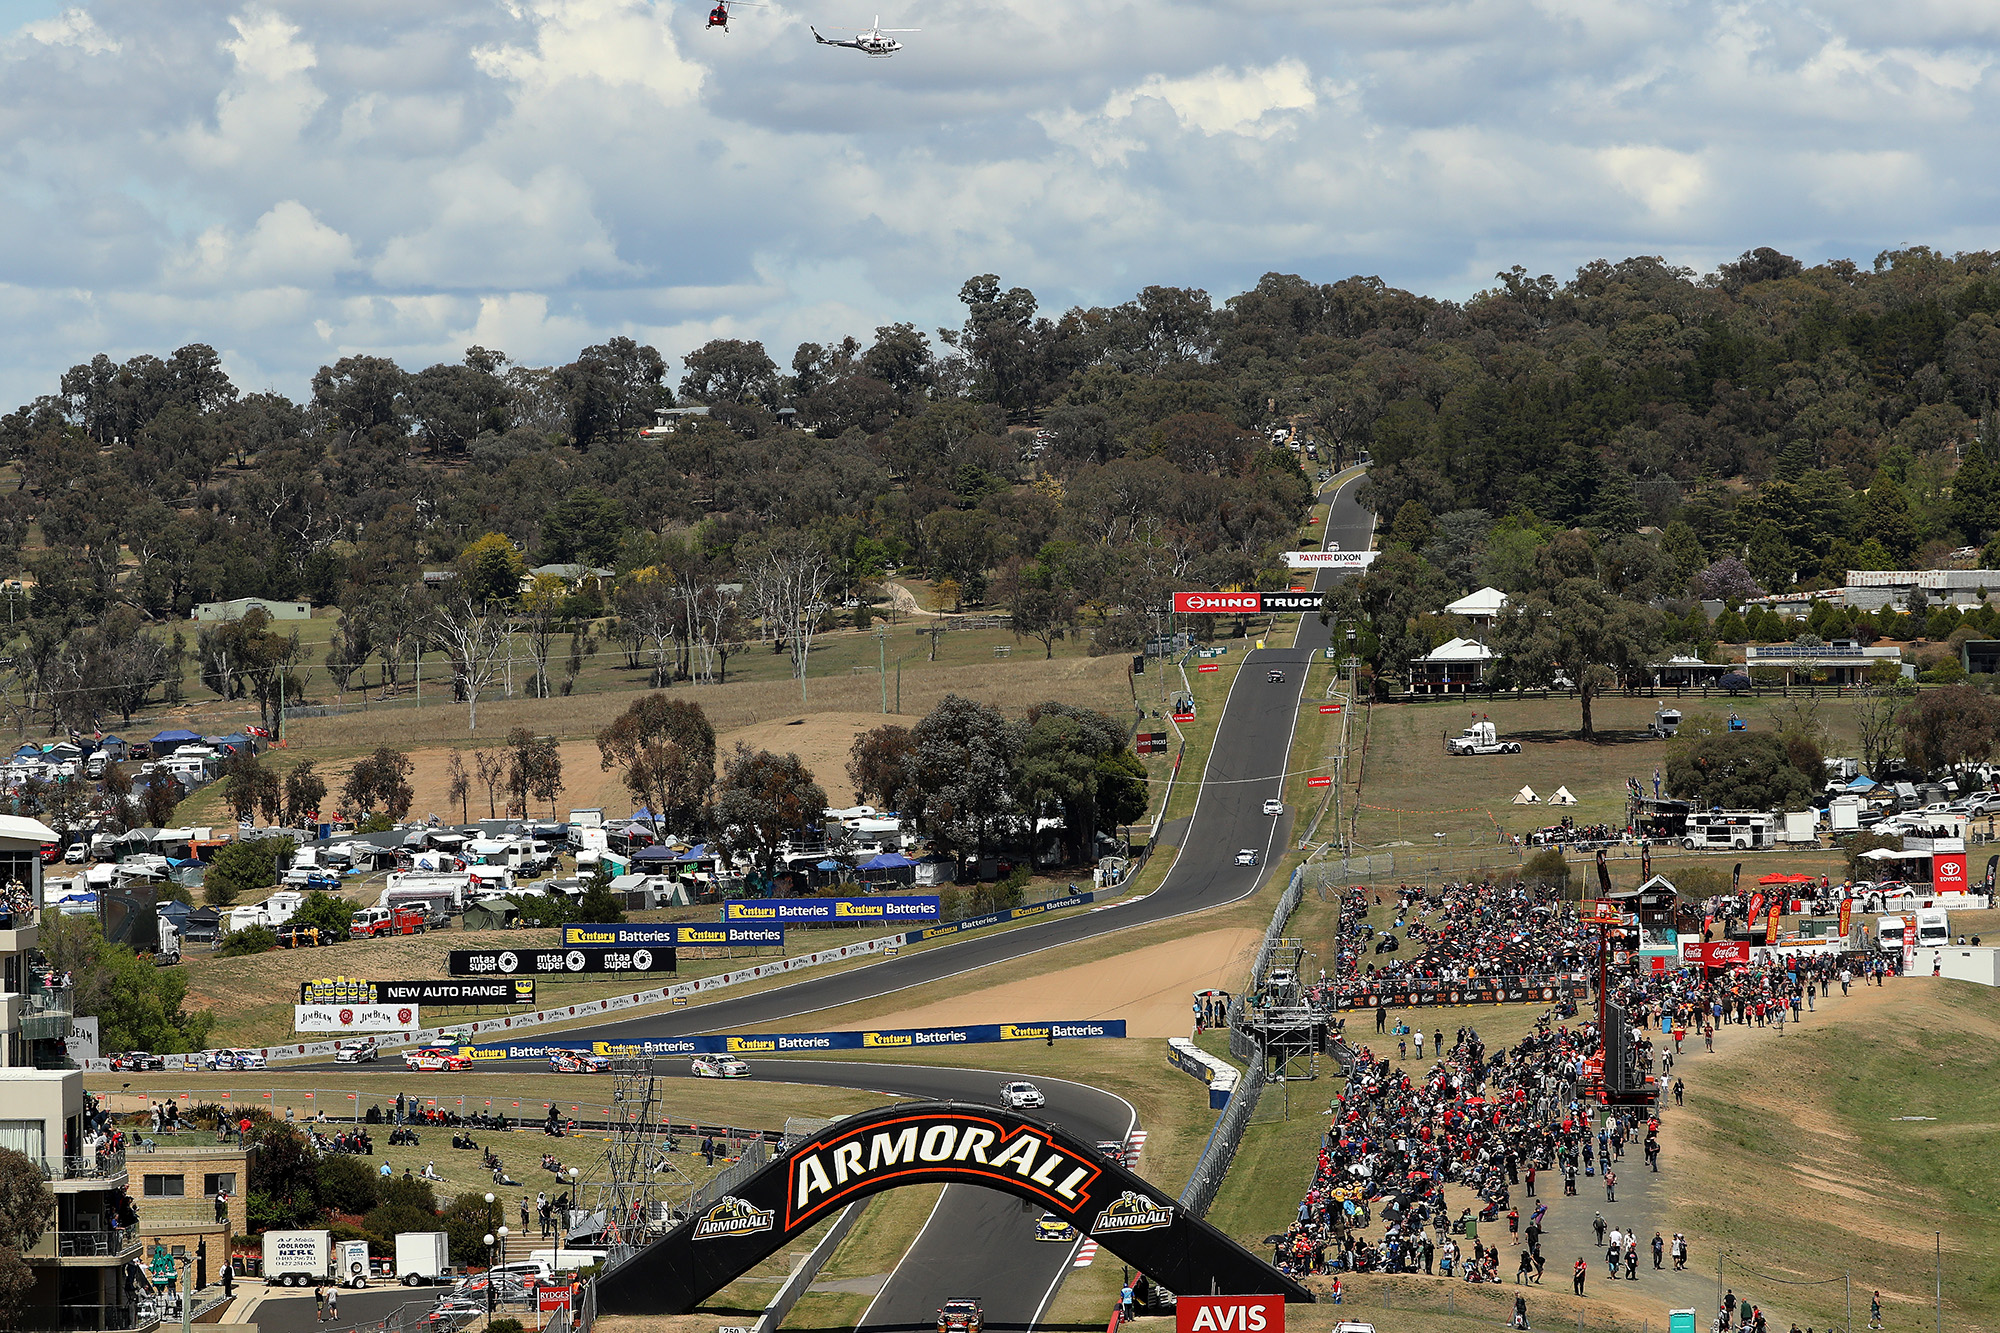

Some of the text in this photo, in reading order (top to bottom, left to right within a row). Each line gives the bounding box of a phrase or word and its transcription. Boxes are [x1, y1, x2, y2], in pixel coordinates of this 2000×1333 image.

[1206, 597, 1322, 608] HINO TRUCK
[836, 902, 936, 917] Century Batteries
[1046, 897, 1081, 910] Batteries
[728, 904, 829, 918] Century Batteries
[961, 915, 998, 930] Batteries
[566, 928, 671, 944] Century Batteries
[677, 927, 781, 942] Century Batteries
[470, 954, 496, 964] mtaa
[537, 953, 563, 962] mtaa
[604, 952, 630, 961] mtaa
[1712, 946, 1740, 959] Coca-Cola
[470, 963, 498, 973] super
[537, 962, 565, 971] super
[604, 960, 632, 970] super
[388, 985, 507, 998] NEW AUTO RANGE
[863, 1030, 966, 1047] Century Batteries
[1000, 1024, 1104, 1040] Century Batteries
[644, 1040, 695, 1052] Batteries
[726, 1037, 830, 1052] Century Batteries
[458, 1046, 507, 1060] Century
[540, 1291, 569, 1299] RYDGES
[1192, 1304, 1268, 1332] AVIS
